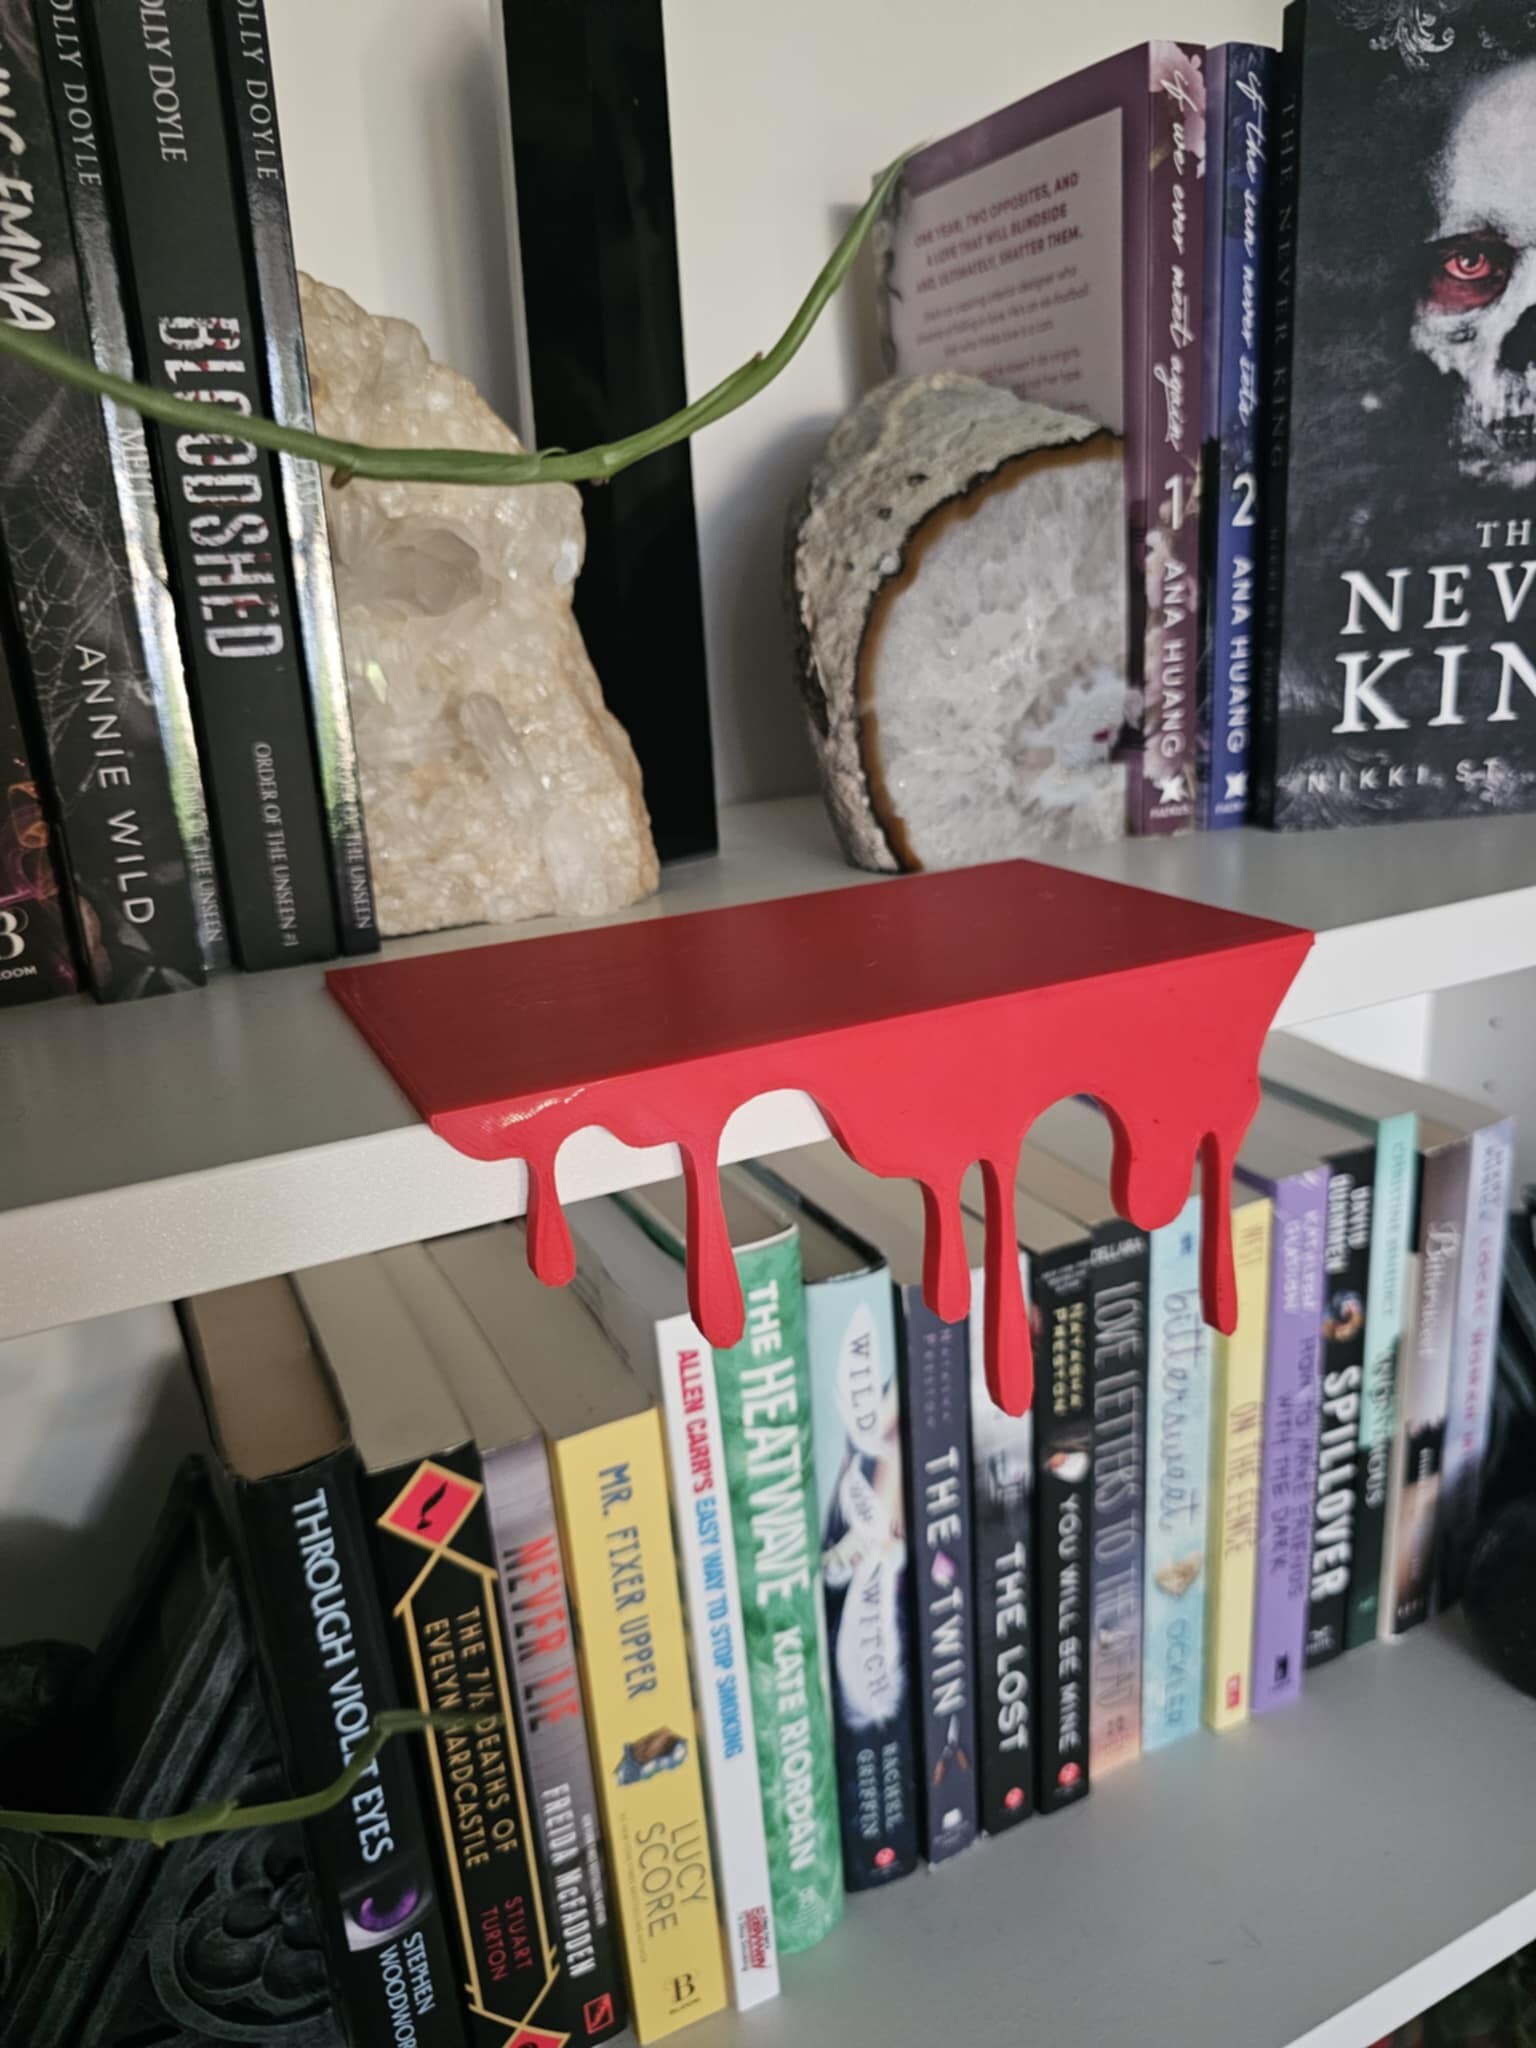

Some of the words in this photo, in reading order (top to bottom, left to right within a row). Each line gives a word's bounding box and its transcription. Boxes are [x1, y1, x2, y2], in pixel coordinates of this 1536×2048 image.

[51, 0, 84, 69] OLLY
[140, 0, 173, 59] LLY
[63, 81, 102, 187] DOYLE
[148, 63, 188, 162] DOYLE
[246, 79, 279, 180] DOYLE
[1052, 170, 1080, 195] AND
[1171, 184, 1187, 256] ever
[0, 172, 56, 331] EMMA
[1169, 265, 1195, 350] meet
[1241, 264, 1256, 350] never
[1164, 473, 1185, 531] 1
[1231, 472, 1258, 528] 2
[1476, 518, 1531, 548] TH
[1163, 560, 1187, 630] ANA
[1230, 555, 1255, 627] ANA
[1339, 559, 1536, 635] NEV
[1160, 638, 1187, 759] HUANG
[1227, 635, 1252, 755] HUANG
[1332, 641, 1536, 735] KIN
[75, 643, 132, 789] ANNIE
[107, 808, 155, 926] WILD
[254, 742, 279, 802] ORDER
[263, 804, 283, 828] OF
[266, 830, 289, 863] THE
[198, 880, 225, 943] UNSEEN
[272, 864, 298, 931] UNSEEN
[350, 865, 374, 930] UNSEEN
[0, 965, 38, 980] OOM
[748, 1278, 783, 1358] THE
[1093, 1280, 1143, 1370] LOVE
[677, 1349, 705, 1415] ALLEN
[849, 1331, 878, 1432] WILD
[1270, 1393, 1292, 1446] WITH
[685, 1417, 715, 1495] CARR'S
[1093, 1367, 1142, 1515] LETTERS
[1271, 1454, 1291, 1499] THE
[597, 1461, 634, 1517] MR.
[694, 1494, 721, 1546] EASY
[739, 1354, 812, 1608] HEATWAVE
[925, 1445, 961, 1549] THE
[1309, 1364, 1361, 1602] SPILLOVER
[1058, 1491, 1083, 1562] YOU
[1094, 1508, 1140, 1565] TO
[1269, 1505, 1290, 1576] DARK
[502, 1531, 569, 1664] NEVER
[605, 1524, 647, 1613] FIXER
[701, 1549, 726, 1592] WAY
[706, 1591, 730, 1621] TO
[995, 1540, 1028, 1641] THE
[1058, 1561, 1083, 1636] WILL
[423, 1617, 462, 1710] EVELYN
[456, 1604, 487, 1660] THE
[618, 1614, 659, 1701] UPPER
[710, 1622, 735, 1670] STOP
[772, 1625, 809, 1714] KATE
[859, 1580, 893, 1701] WITCH
[929, 1585, 967, 1719] TWIN
[1058, 1635, 1083, 1683] BE
[291, 1487, 357, 1669] THROUGH
[351, 1784, 395, 1864] EYES
[524, 1665, 581, 1734] LIE
[997, 1643, 1030, 1752] LOST
[716, 1673, 745, 1761] SMOKING
[1058, 1681, 1083, 1757] MINE
[474, 1713, 511, 1812] DEATHS
[780, 1713, 818, 1873] RIORDAN
[882, 1740, 904, 1832] RACHEL
[490, 1817, 519, 1854] OF
[540, 1781, 580, 1867] FREIDA
[670, 1818, 708, 1905] LUCY
[635, 1820, 679, 1938] SCORE
[480, 1904, 509, 1983] TURTON
[503, 1895, 535, 1970] STUART
[378, 1943, 418, 2048] WOODWOR
[402, 1930, 437, 2016] STEPHEN
